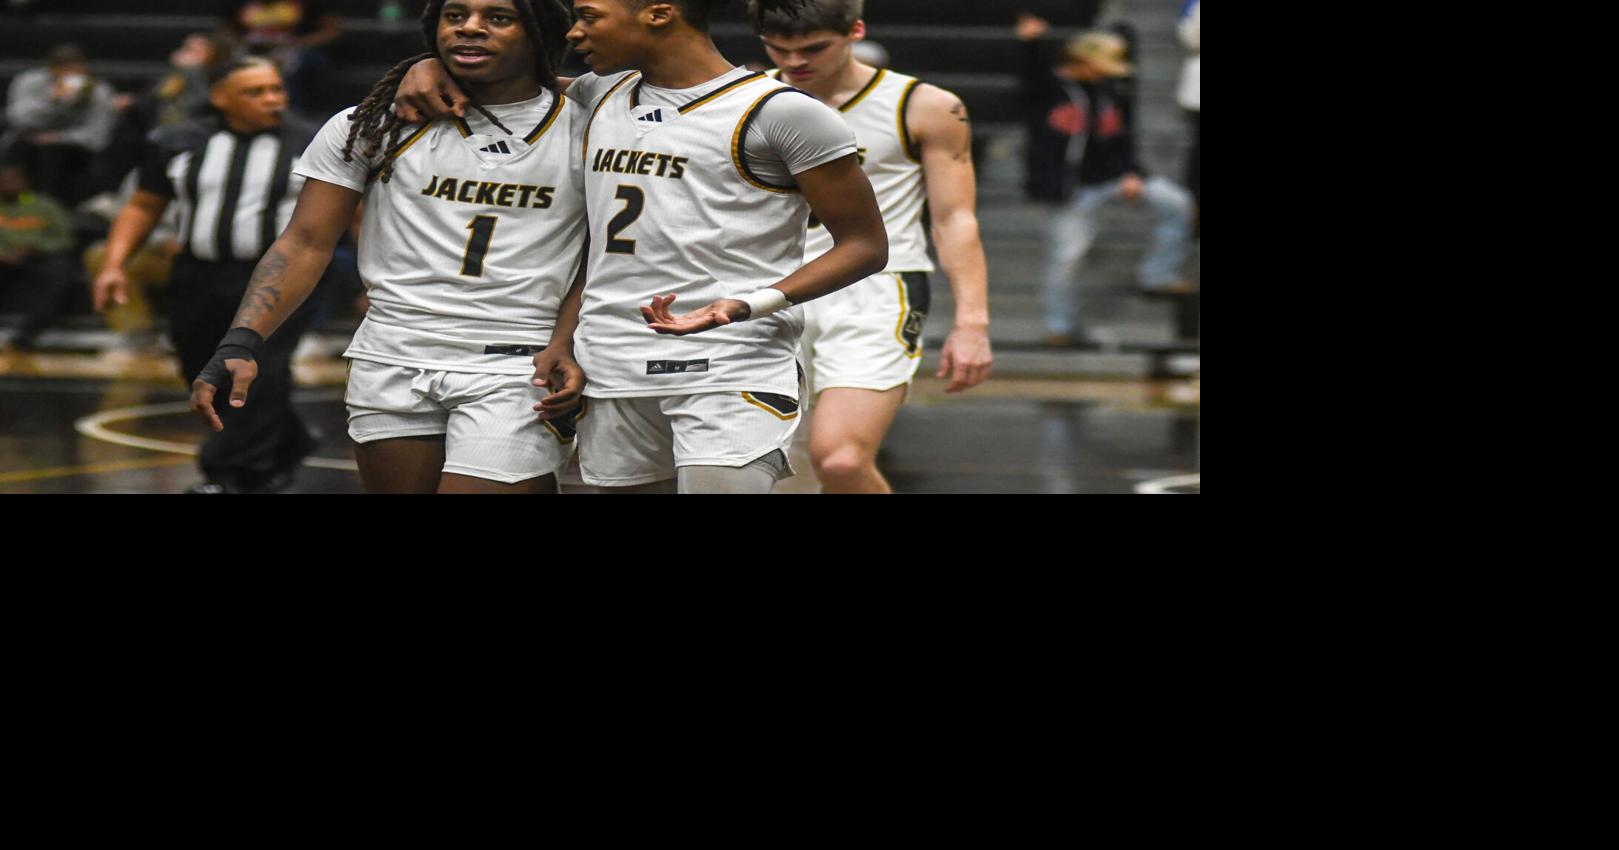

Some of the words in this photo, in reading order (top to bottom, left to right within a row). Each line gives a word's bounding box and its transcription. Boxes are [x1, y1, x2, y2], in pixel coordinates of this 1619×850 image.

[592, 148, 689, 179] JACKETS
[421, 174, 556, 209] JACKETS
[604, 184, 645, 255] 2
[460, 214, 498, 278] 1
